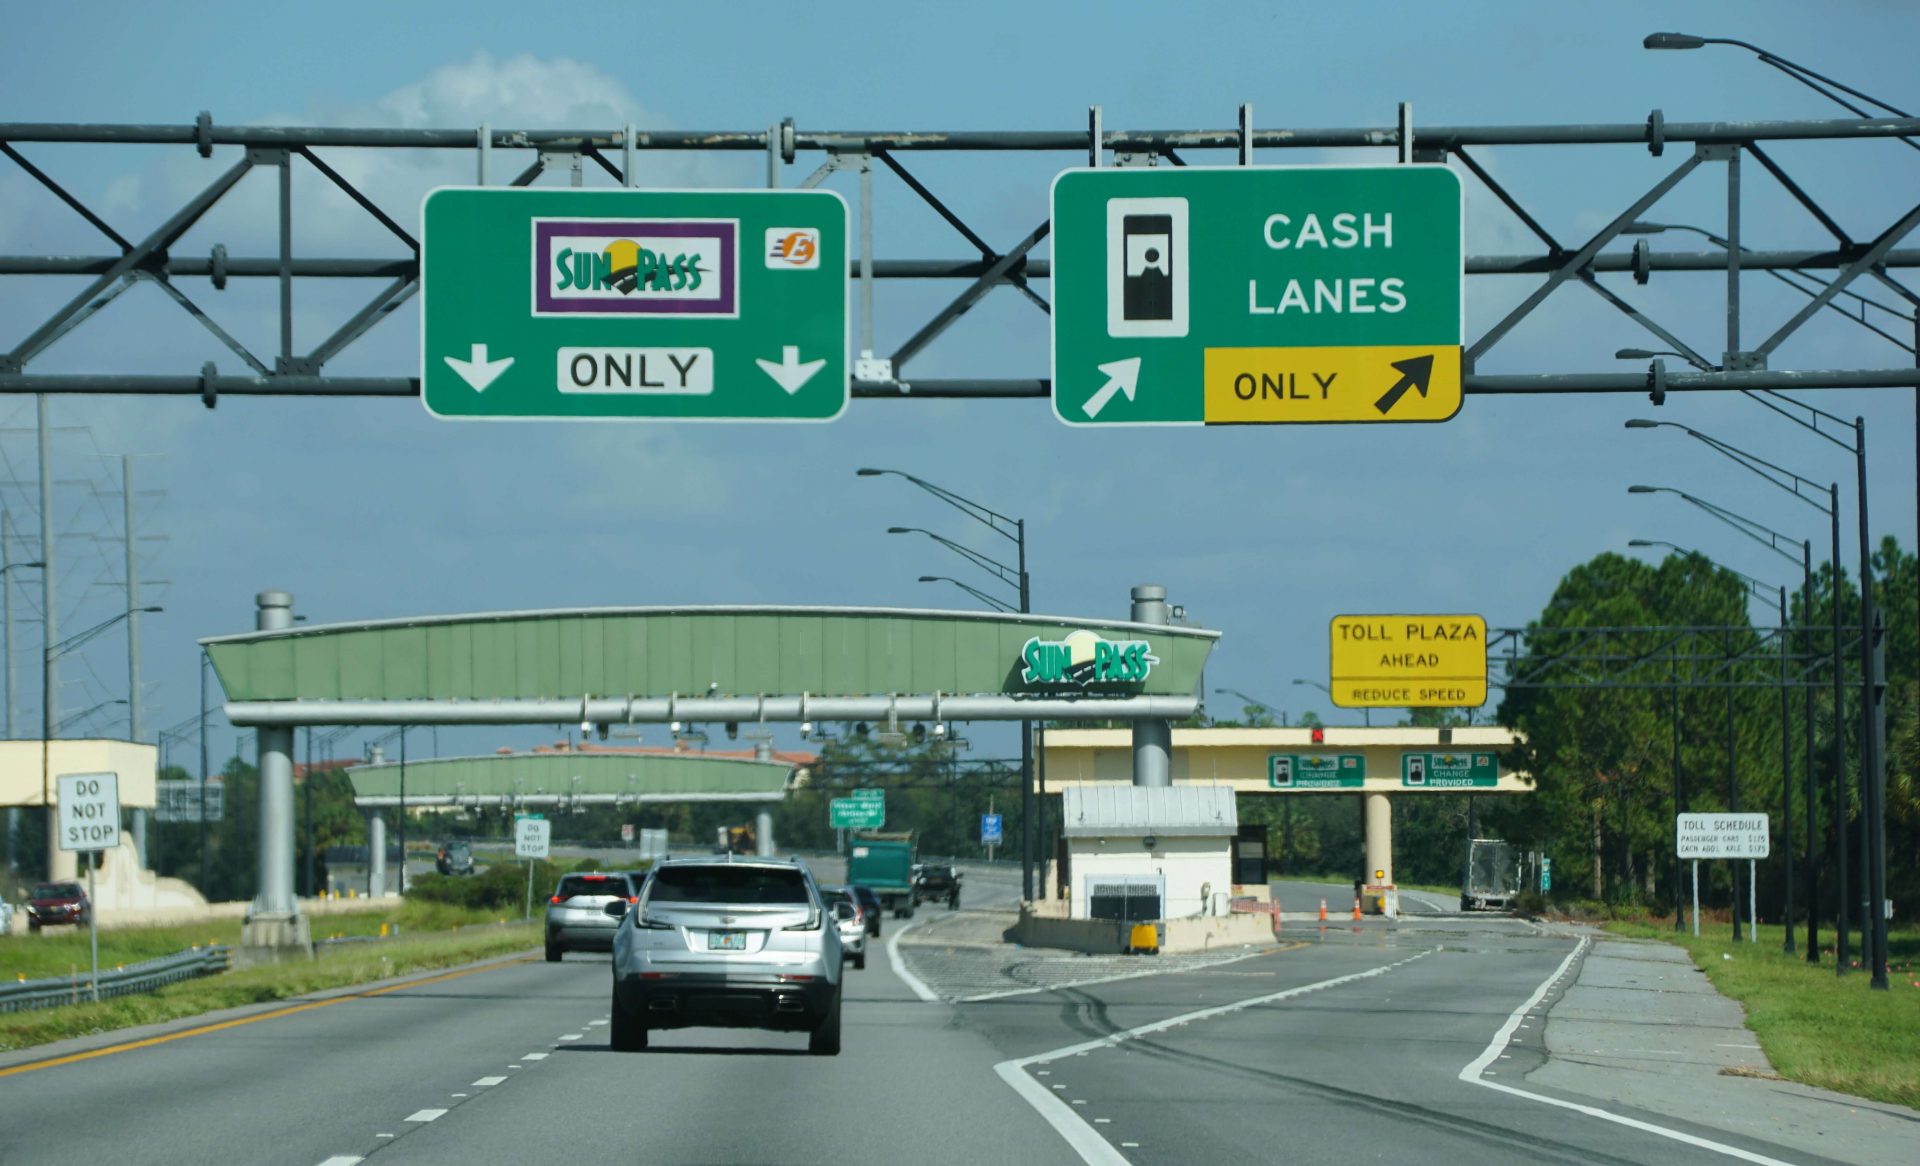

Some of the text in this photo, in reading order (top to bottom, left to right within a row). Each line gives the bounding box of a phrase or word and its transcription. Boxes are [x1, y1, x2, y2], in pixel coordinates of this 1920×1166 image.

[1263, 212, 1393, 249] CASH
[1249, 278, 1407, 314] LANES
[570, 353, 699, 388] ONLY
[1234, 372, 1338, 400] ONLY
[1339, 624, 1477, 641] TOLL PLAZA
[1380, 653, 1439, 667] AHEAD
[1352, 688, 1466, 701] REDUCE SPEED
[76, 780, 99, 796] DO
[72, 804, 106, 819] NOT
[69, 825, 113, 842] STOP
[527, 824, 539, 833] DO
[1683, 820, 1763, 831] TOLL SCHEDULE
[520, 844, 544, 852] STOP
